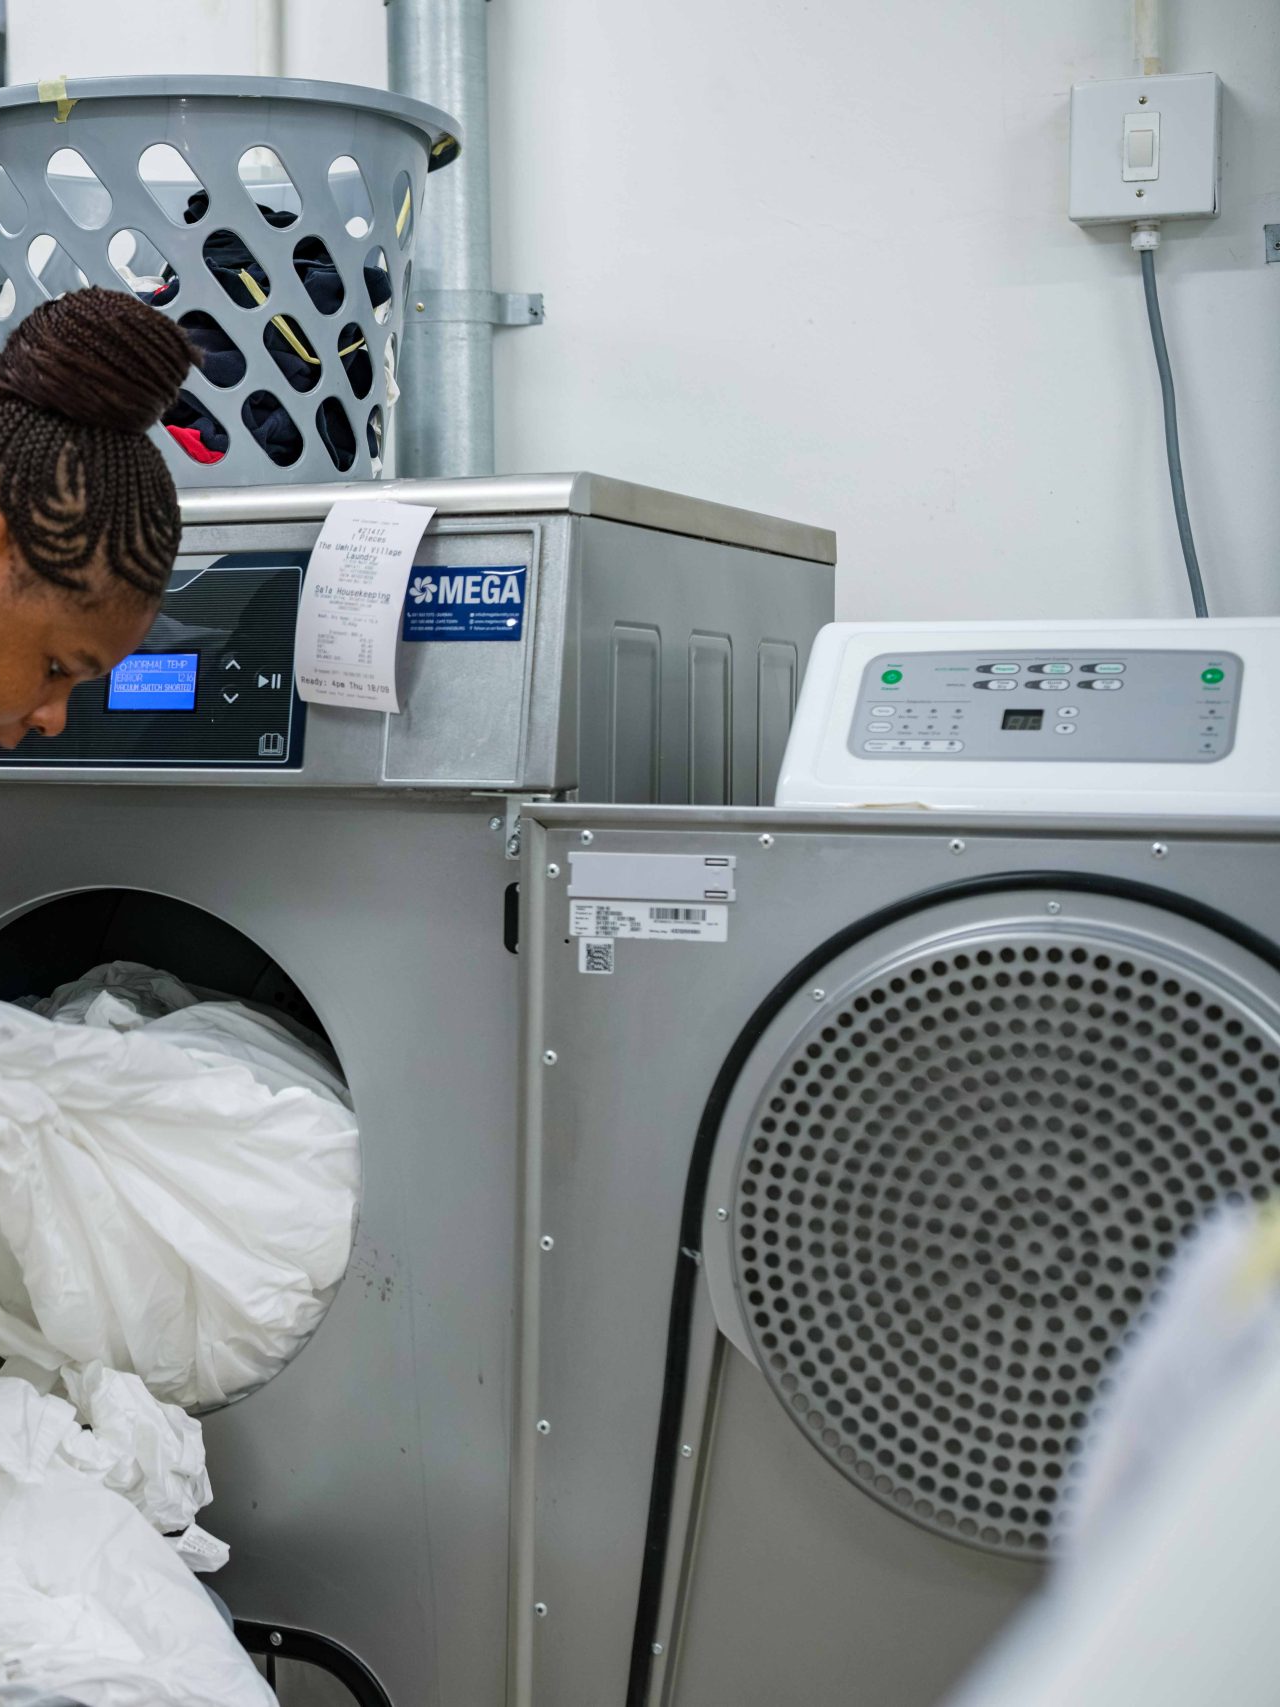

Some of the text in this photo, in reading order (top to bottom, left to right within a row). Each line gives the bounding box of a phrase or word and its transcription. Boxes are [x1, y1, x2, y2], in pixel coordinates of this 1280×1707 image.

[319, 541, 332, 550] The
[371, 546, 403, 557] Village
[346, 552, 378, 562] Laundry
[337, 586, 391, 601] Housekeeping
[438, 575, 521, 605] MEGA
[167, 659, 188, 669] TEMP
[116, 672, 143, 682] ERROR
[300, 675, 327, 687] Ready:
[332, 679, 346, 689] 4pm
[349, 681, 363, 691] Thu
[141, 683, 163, 692] SWITCH
